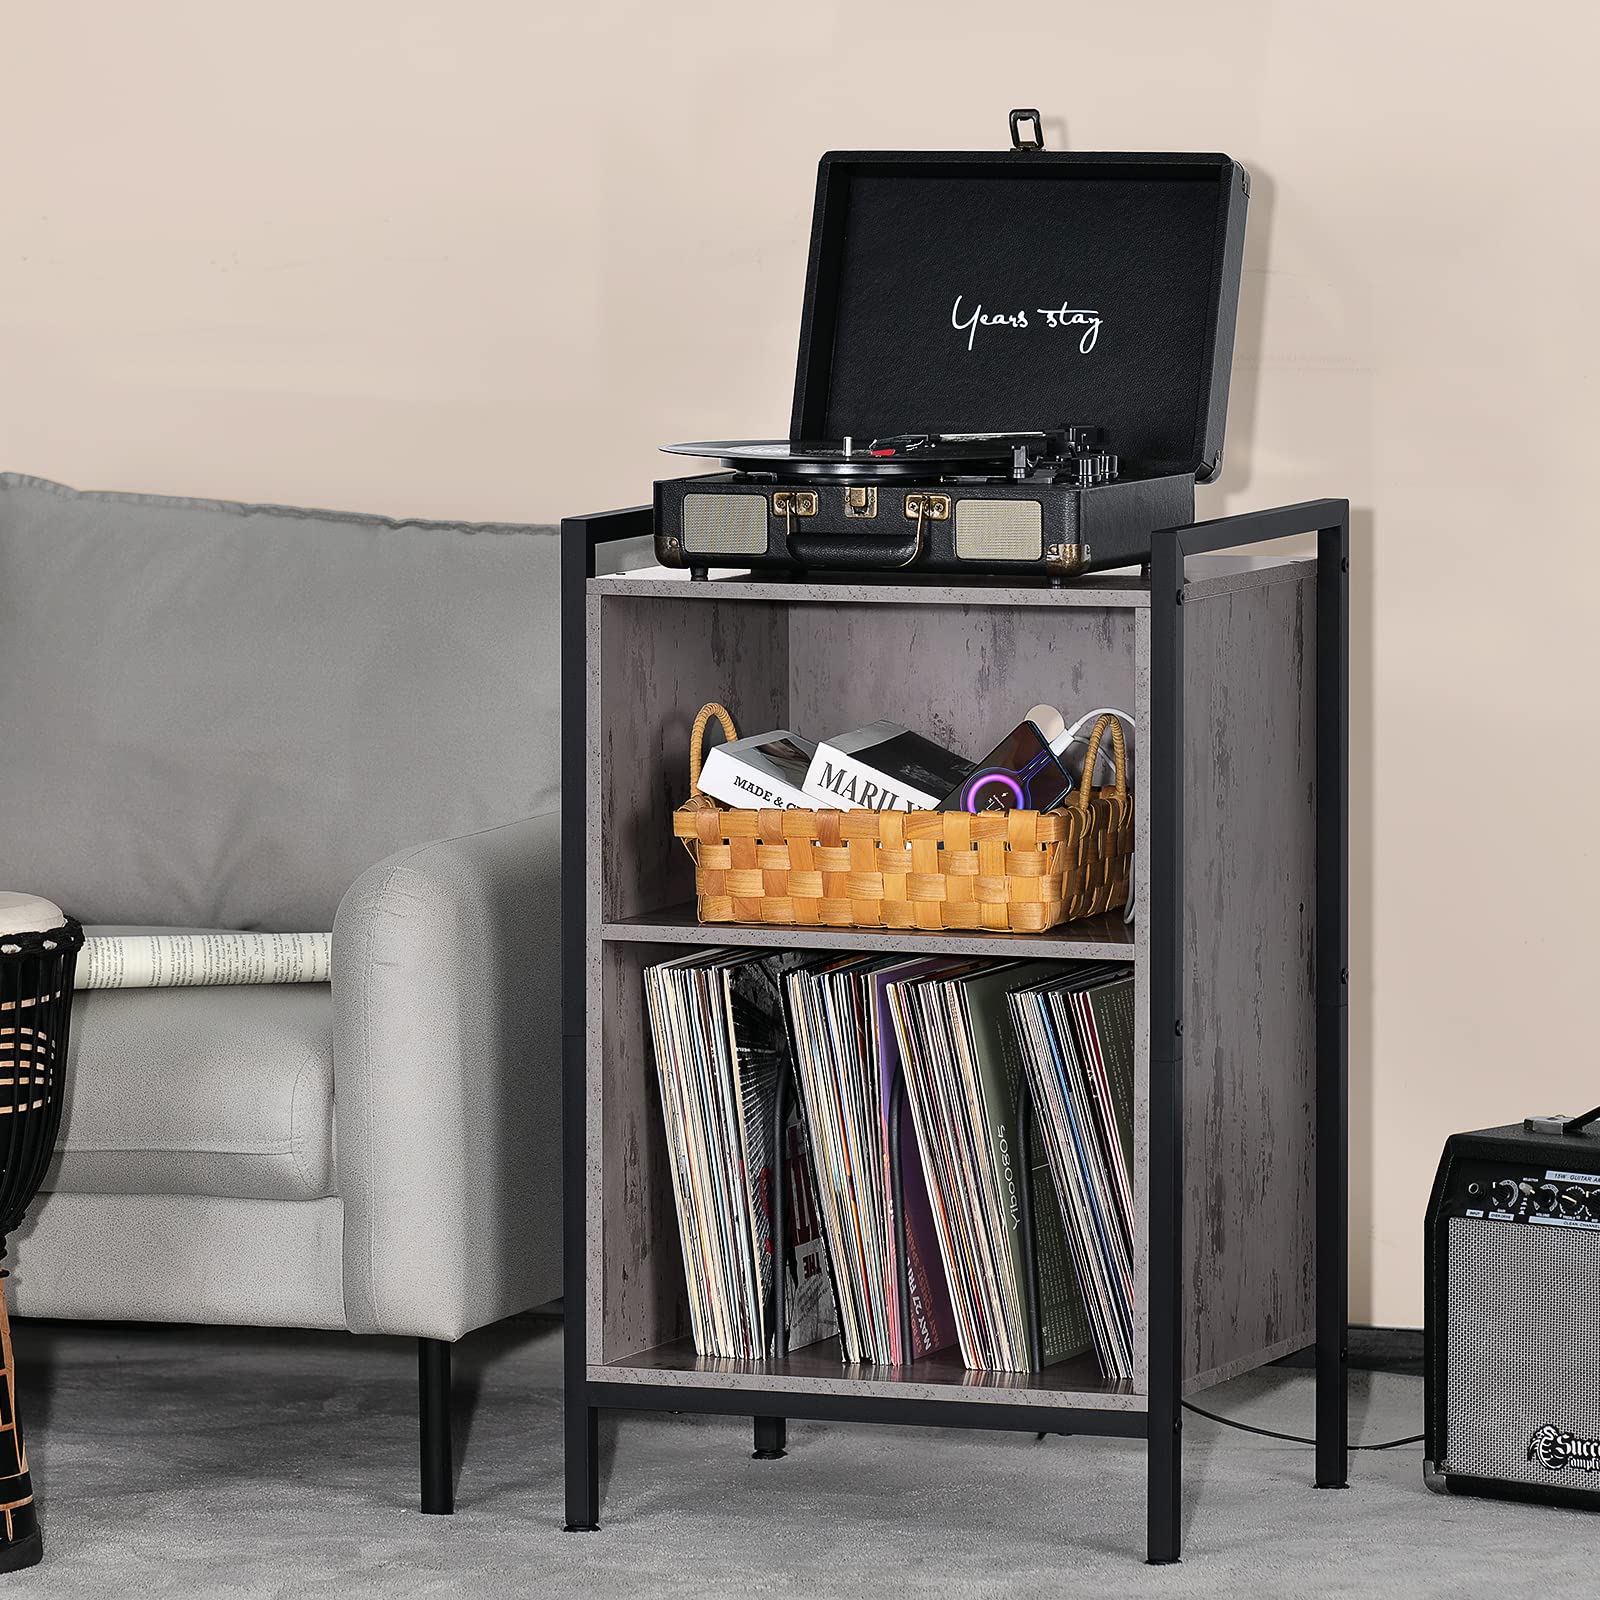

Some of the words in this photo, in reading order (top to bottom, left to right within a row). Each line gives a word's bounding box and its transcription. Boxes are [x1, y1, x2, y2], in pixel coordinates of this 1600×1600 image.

[952, 295, 1028, 351] Years
[1037, 301, 1103, 354] stay
[733, 775, 773, 801] MADE
[773, 796, 784, 807] &
[1570, 1174, 1592, 1182] GUITAR
[907, 1267, 917, 1295] FRI
[912, 1295, 923, 1315] 27
[918, 1315, 932, 1351] MAY
[1554, 1432, 1600, 1459] Succ
